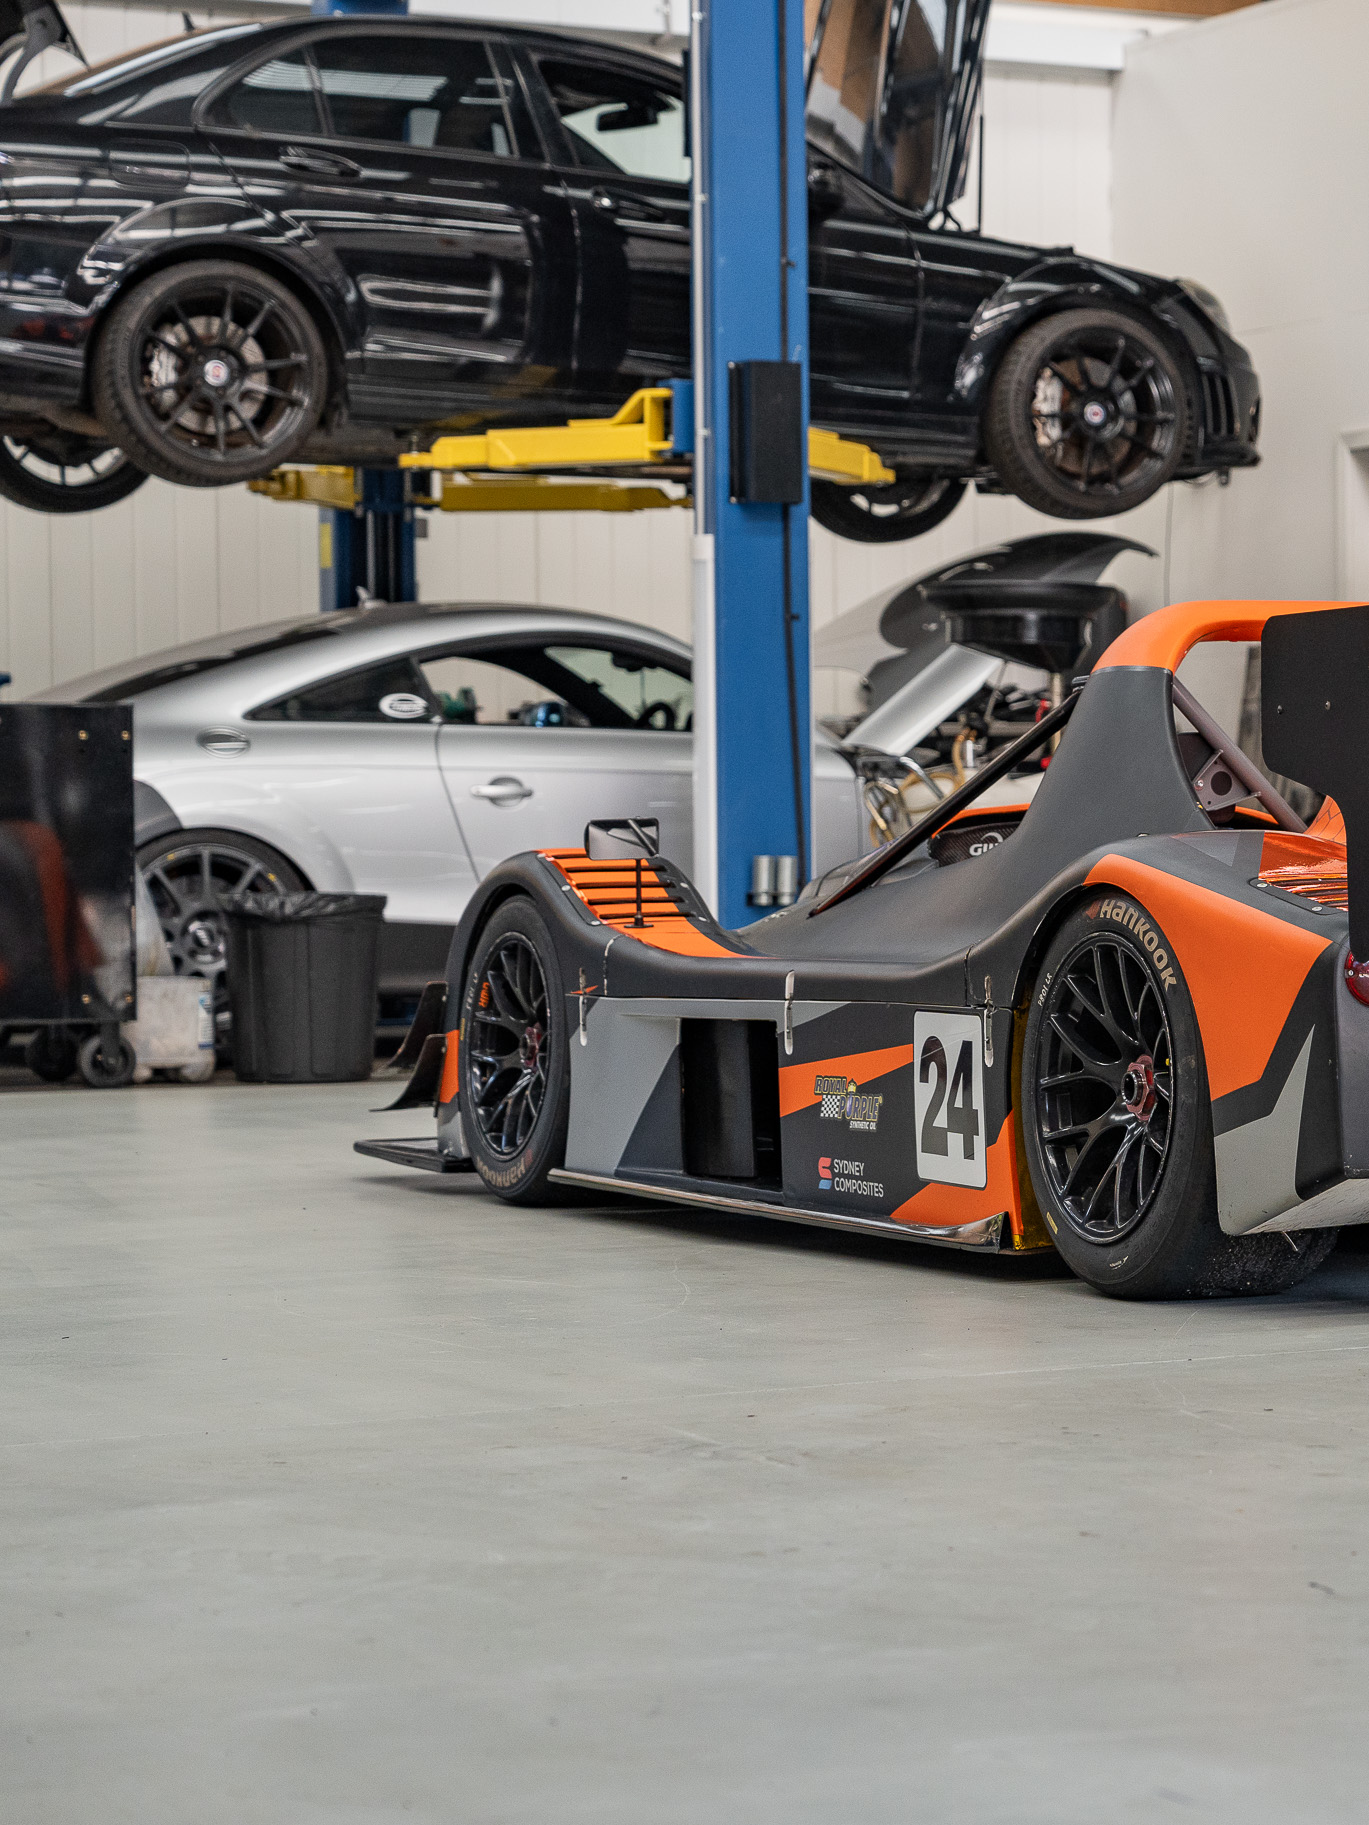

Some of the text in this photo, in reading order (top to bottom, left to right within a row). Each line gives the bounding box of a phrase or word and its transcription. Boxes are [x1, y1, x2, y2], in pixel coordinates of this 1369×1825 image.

[814, 1076, 848, 1095] ROYAL
[919, 1035, 979, 1161] 24
[849, 1120, 877, 1130] SYNTHETIC OIL
[833, 1158, 865, 1176] SYDNEY
[833, 1177, 884, 1198] COMPOSITES
